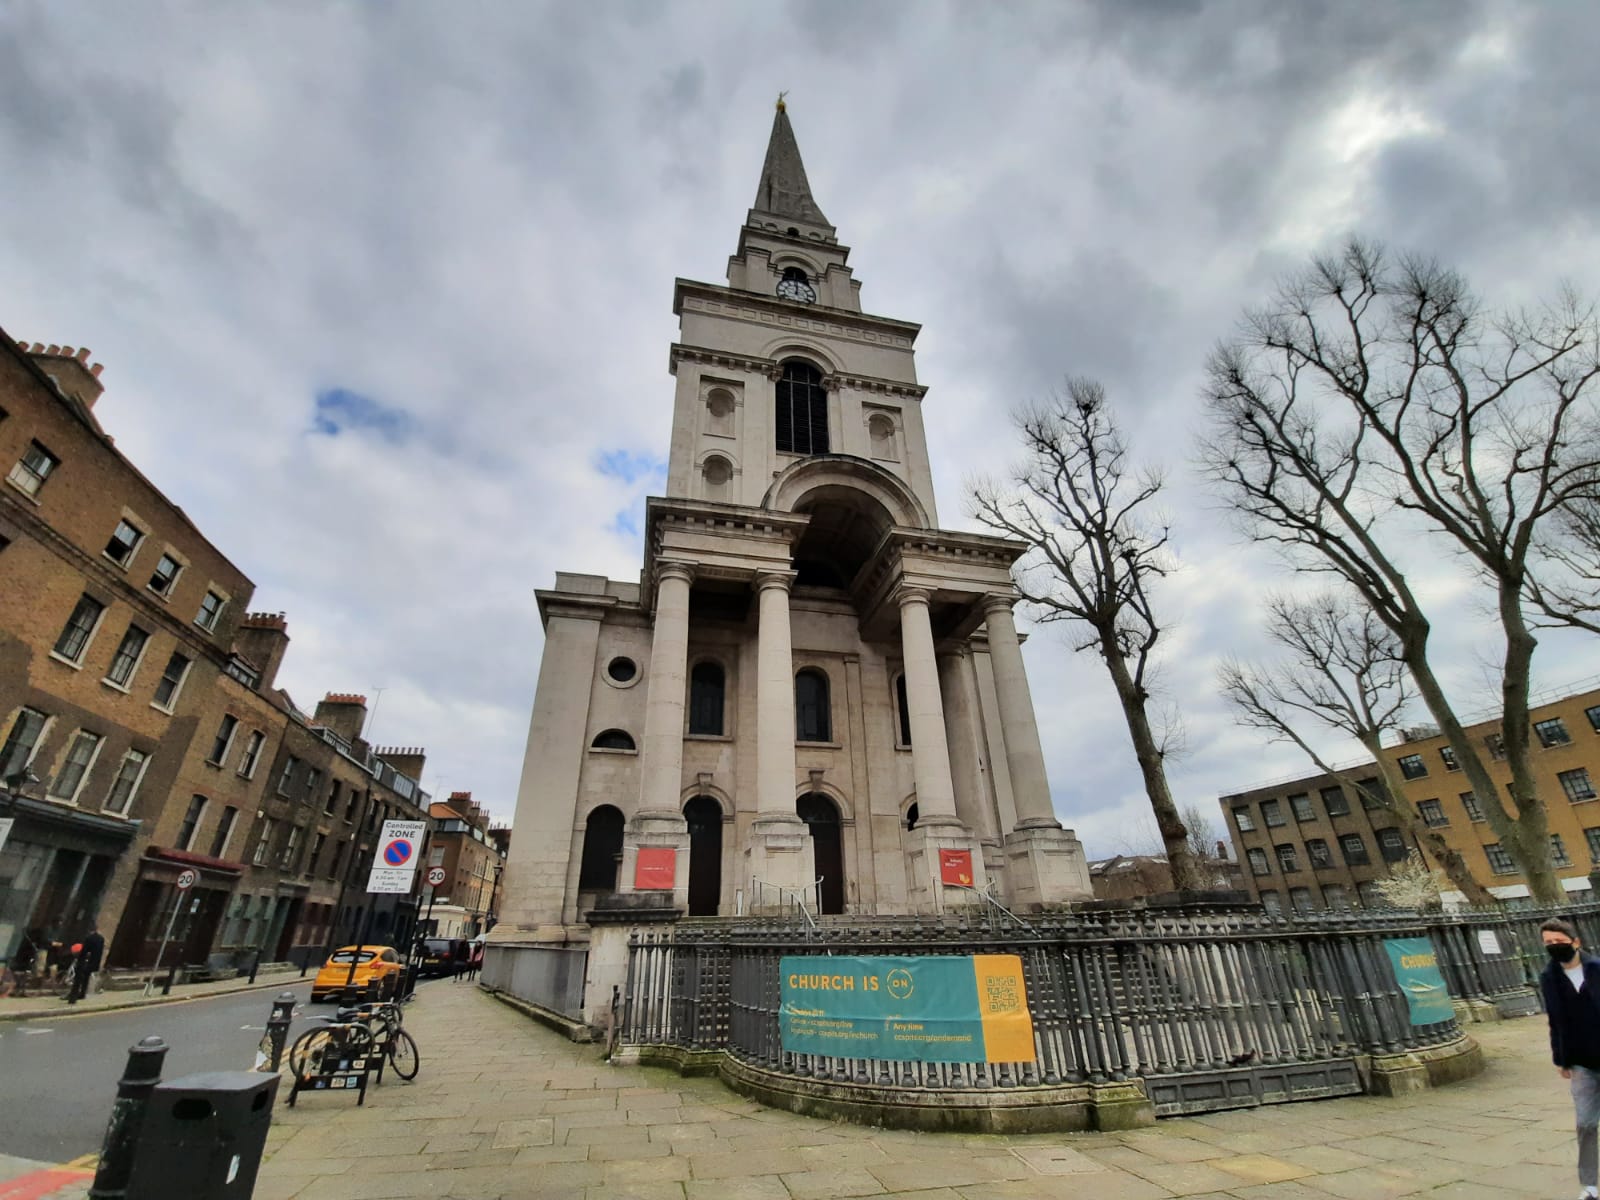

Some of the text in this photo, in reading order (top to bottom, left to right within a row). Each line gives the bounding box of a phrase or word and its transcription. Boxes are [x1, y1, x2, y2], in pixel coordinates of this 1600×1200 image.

[386, 822, 423, 830] Controlled
[389, 830, 415, 838] ZONE
[178, 874, 193, 884] 20
[430, 871, 444, 881] 20
[789, 974, 908, 991] CHURCH IS ON
